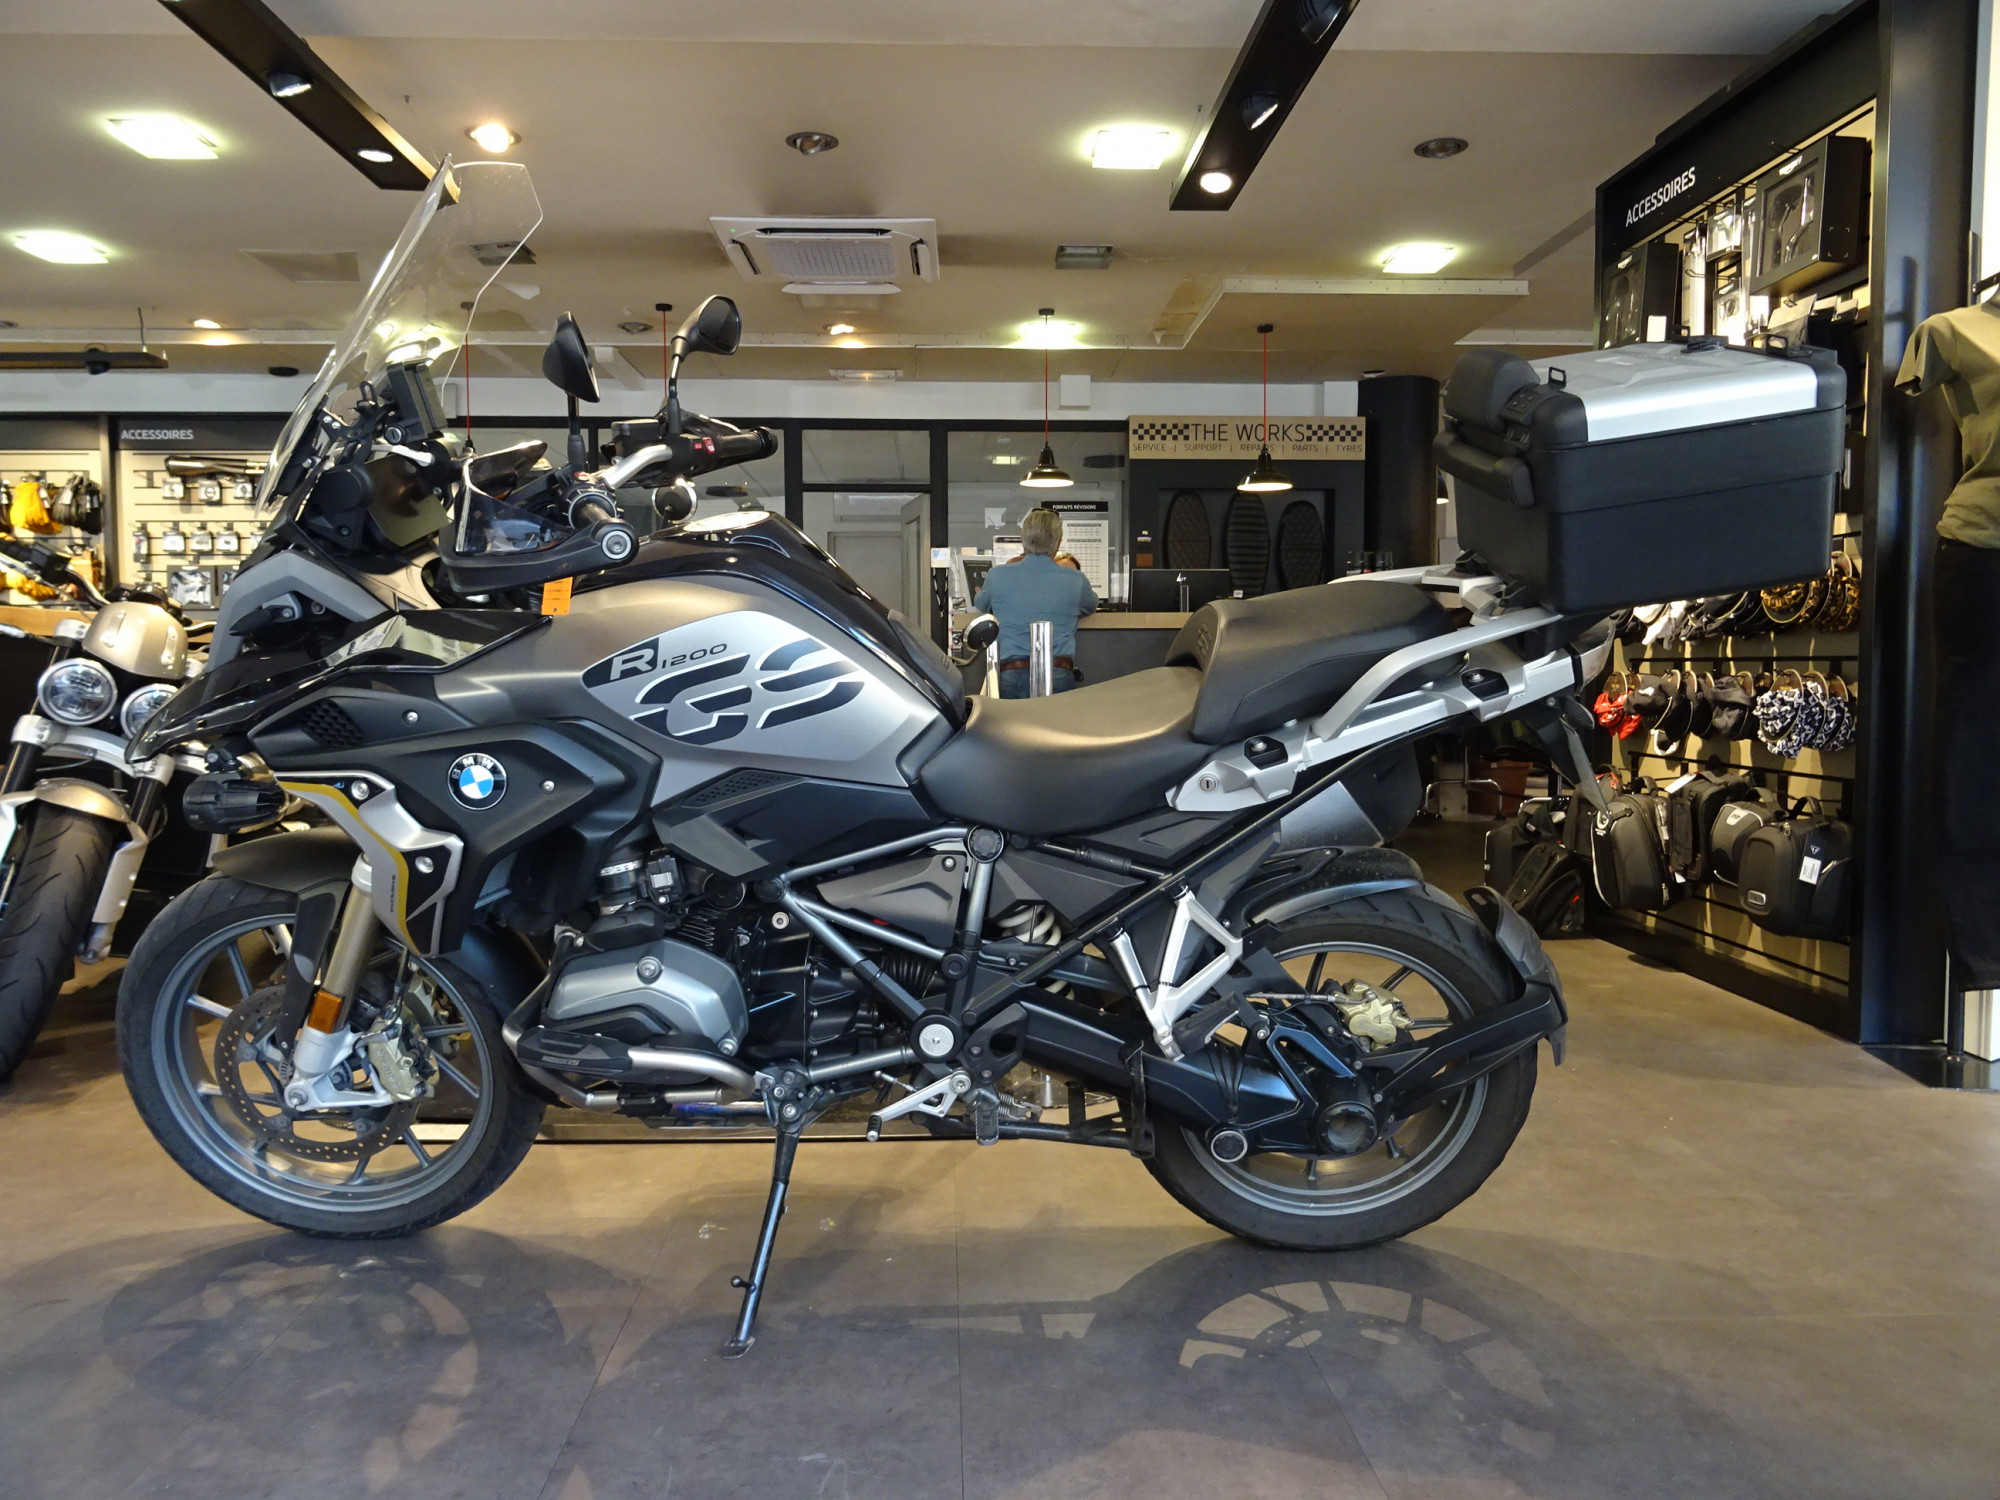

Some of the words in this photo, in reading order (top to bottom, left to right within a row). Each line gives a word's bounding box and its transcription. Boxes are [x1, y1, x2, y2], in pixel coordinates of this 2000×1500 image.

[1625, 166, 1696, 227] ACCESSOIRES
[121, 429, 194, 440] ACCESSOIRES
[1191, 423, 1229, 441] THE
[1235, 423, 1305, 442] WORKS
[1132, 443, 1167, 452] SERVICE
[1183, 443, 1223, 452] SUPPORT
[1240, 443, 1275, 452] REPARS
[1292, 443, 1319, 453] PARTS
[1335, 444, 1363, 453] TYRES
[609, 648, 656, 681] R
[661, 643, 728, 669] 1200
[450, 756, 495, 780] BMW
